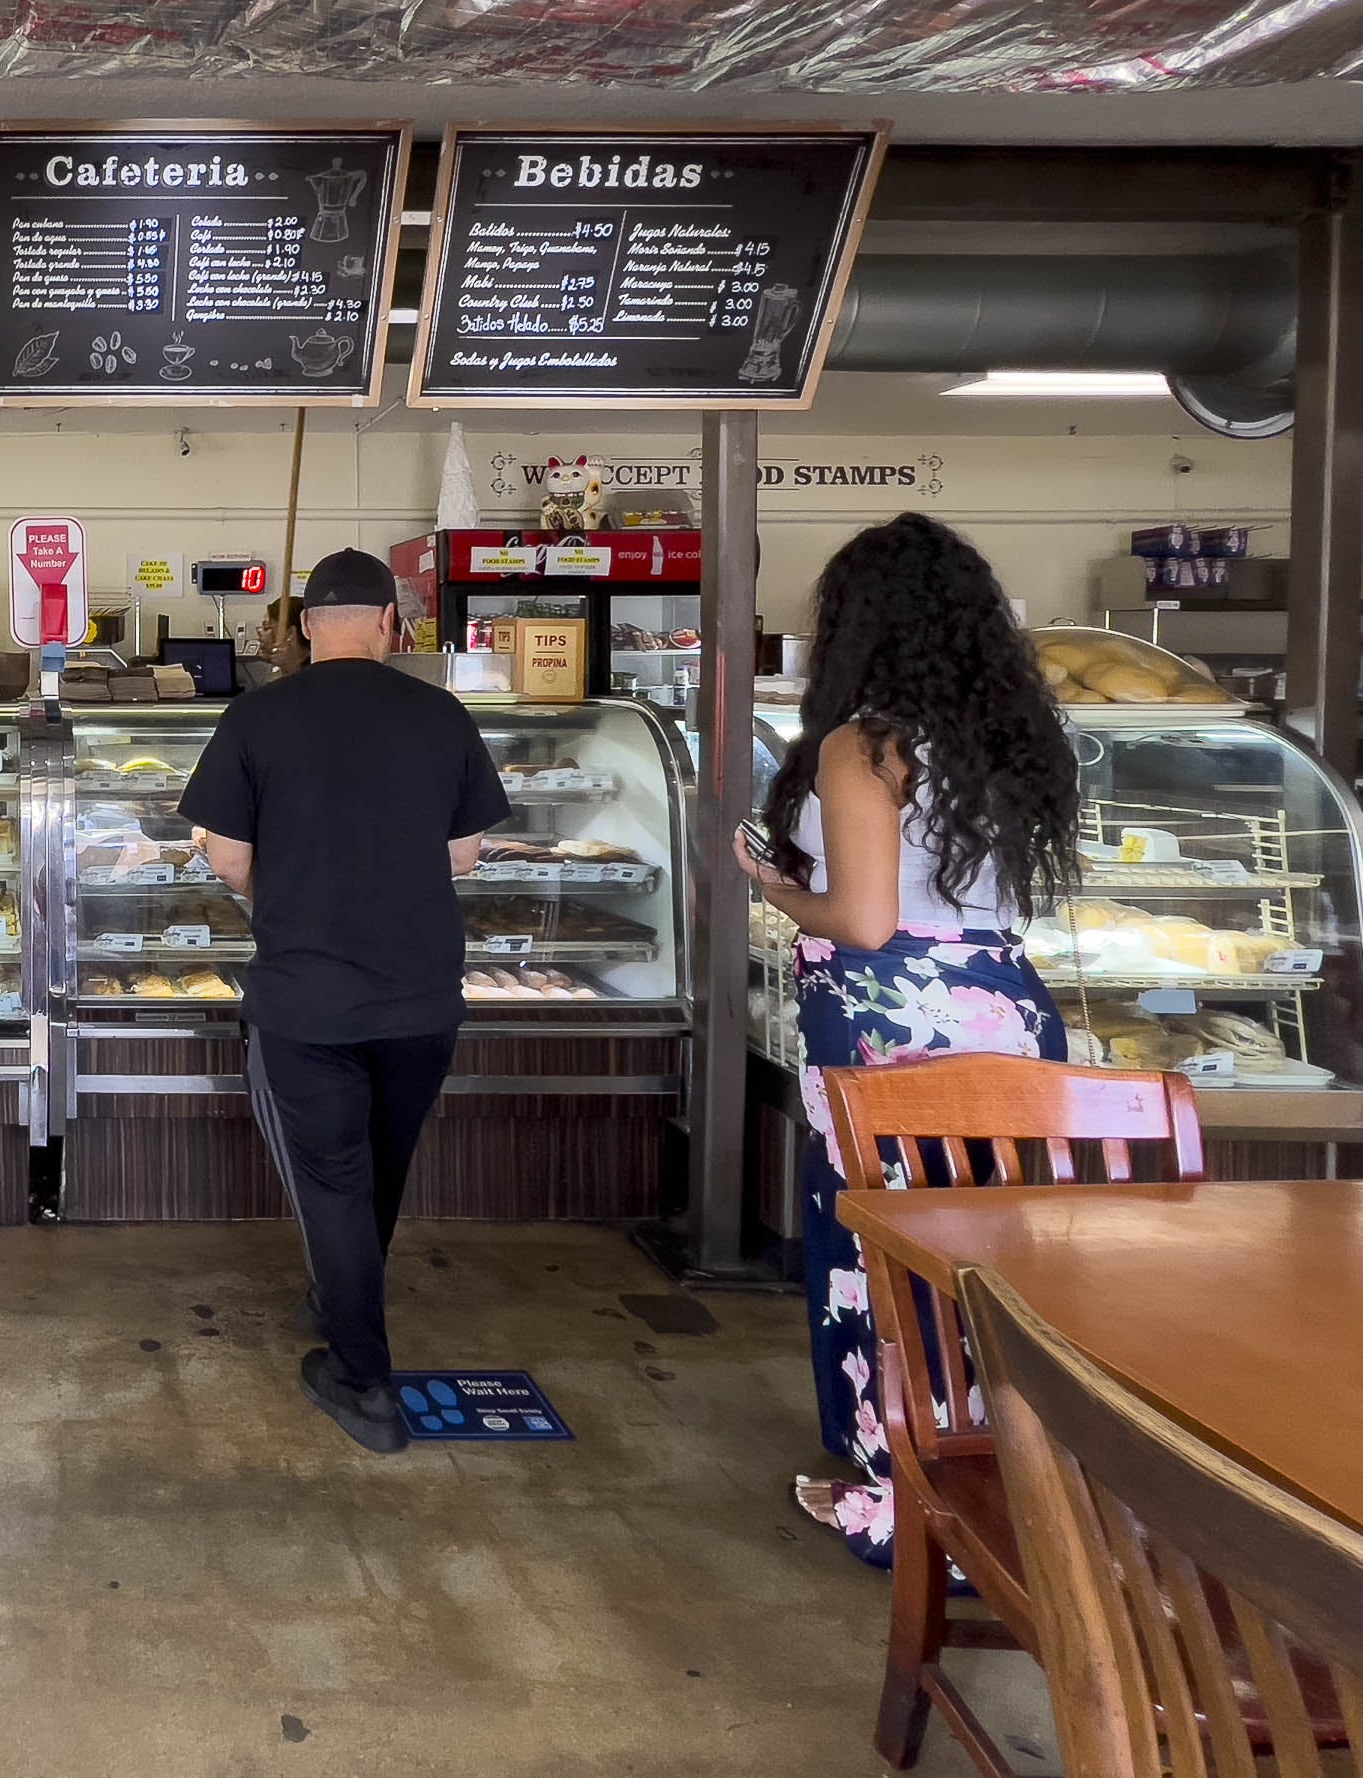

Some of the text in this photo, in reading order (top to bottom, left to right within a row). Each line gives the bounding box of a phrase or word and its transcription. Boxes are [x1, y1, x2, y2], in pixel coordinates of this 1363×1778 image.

[46, 156, 248, 187] Cafeteria
[514, 155, 704, 188] Bebidas
[13, 218, 30, 229] Pan
[469, 222, 514, 237] Batidos
[629, 223, 666, 242] Jugos
[627, 243, 659, 255] Morir
[211, 259, 227, 267] con
[228, 256, 251, 267] leche
[502, 257, 540, 272] Papaya
[623, 260, 667, 275] Naranja
[669, 260, 712, 272] Natural
[210, 272, 225, 280] con
[227, 270, 249, 280] leche
[13, 285, 30, 295] Pan
[216, 286, 231, 294] con
[233, 283, 273, 294] chocolate
[13, 298, 30, 309] Pan
[32, 298, 42, 308] de
[232, 296, 271, 307] chocolate
[458, 294, 508, 312] Country
[510, 294, 540, 308] Club
[618, 293, 674, 306] Tamarindo
[612, 310, 665, 322] Limonada
[450, 352, 618, 370] Sodas y Jugos Embotellados
[601, 466, 690, 486] CCEPT
[794, 465, 916, 486] STAMPS
[29, 534, 66, 543] PLEASE
[33, 547, 63, 555] Take A
[618, 550, 701, 560] enjoy ice col
[31, 560, 66, 568] Number
[242, 566, 261, 589] 10
[535, 635, 566, 646] TIPS
[532, 658, 567, 668] PROPINA
[457, 1379, 502, 1387] Please
